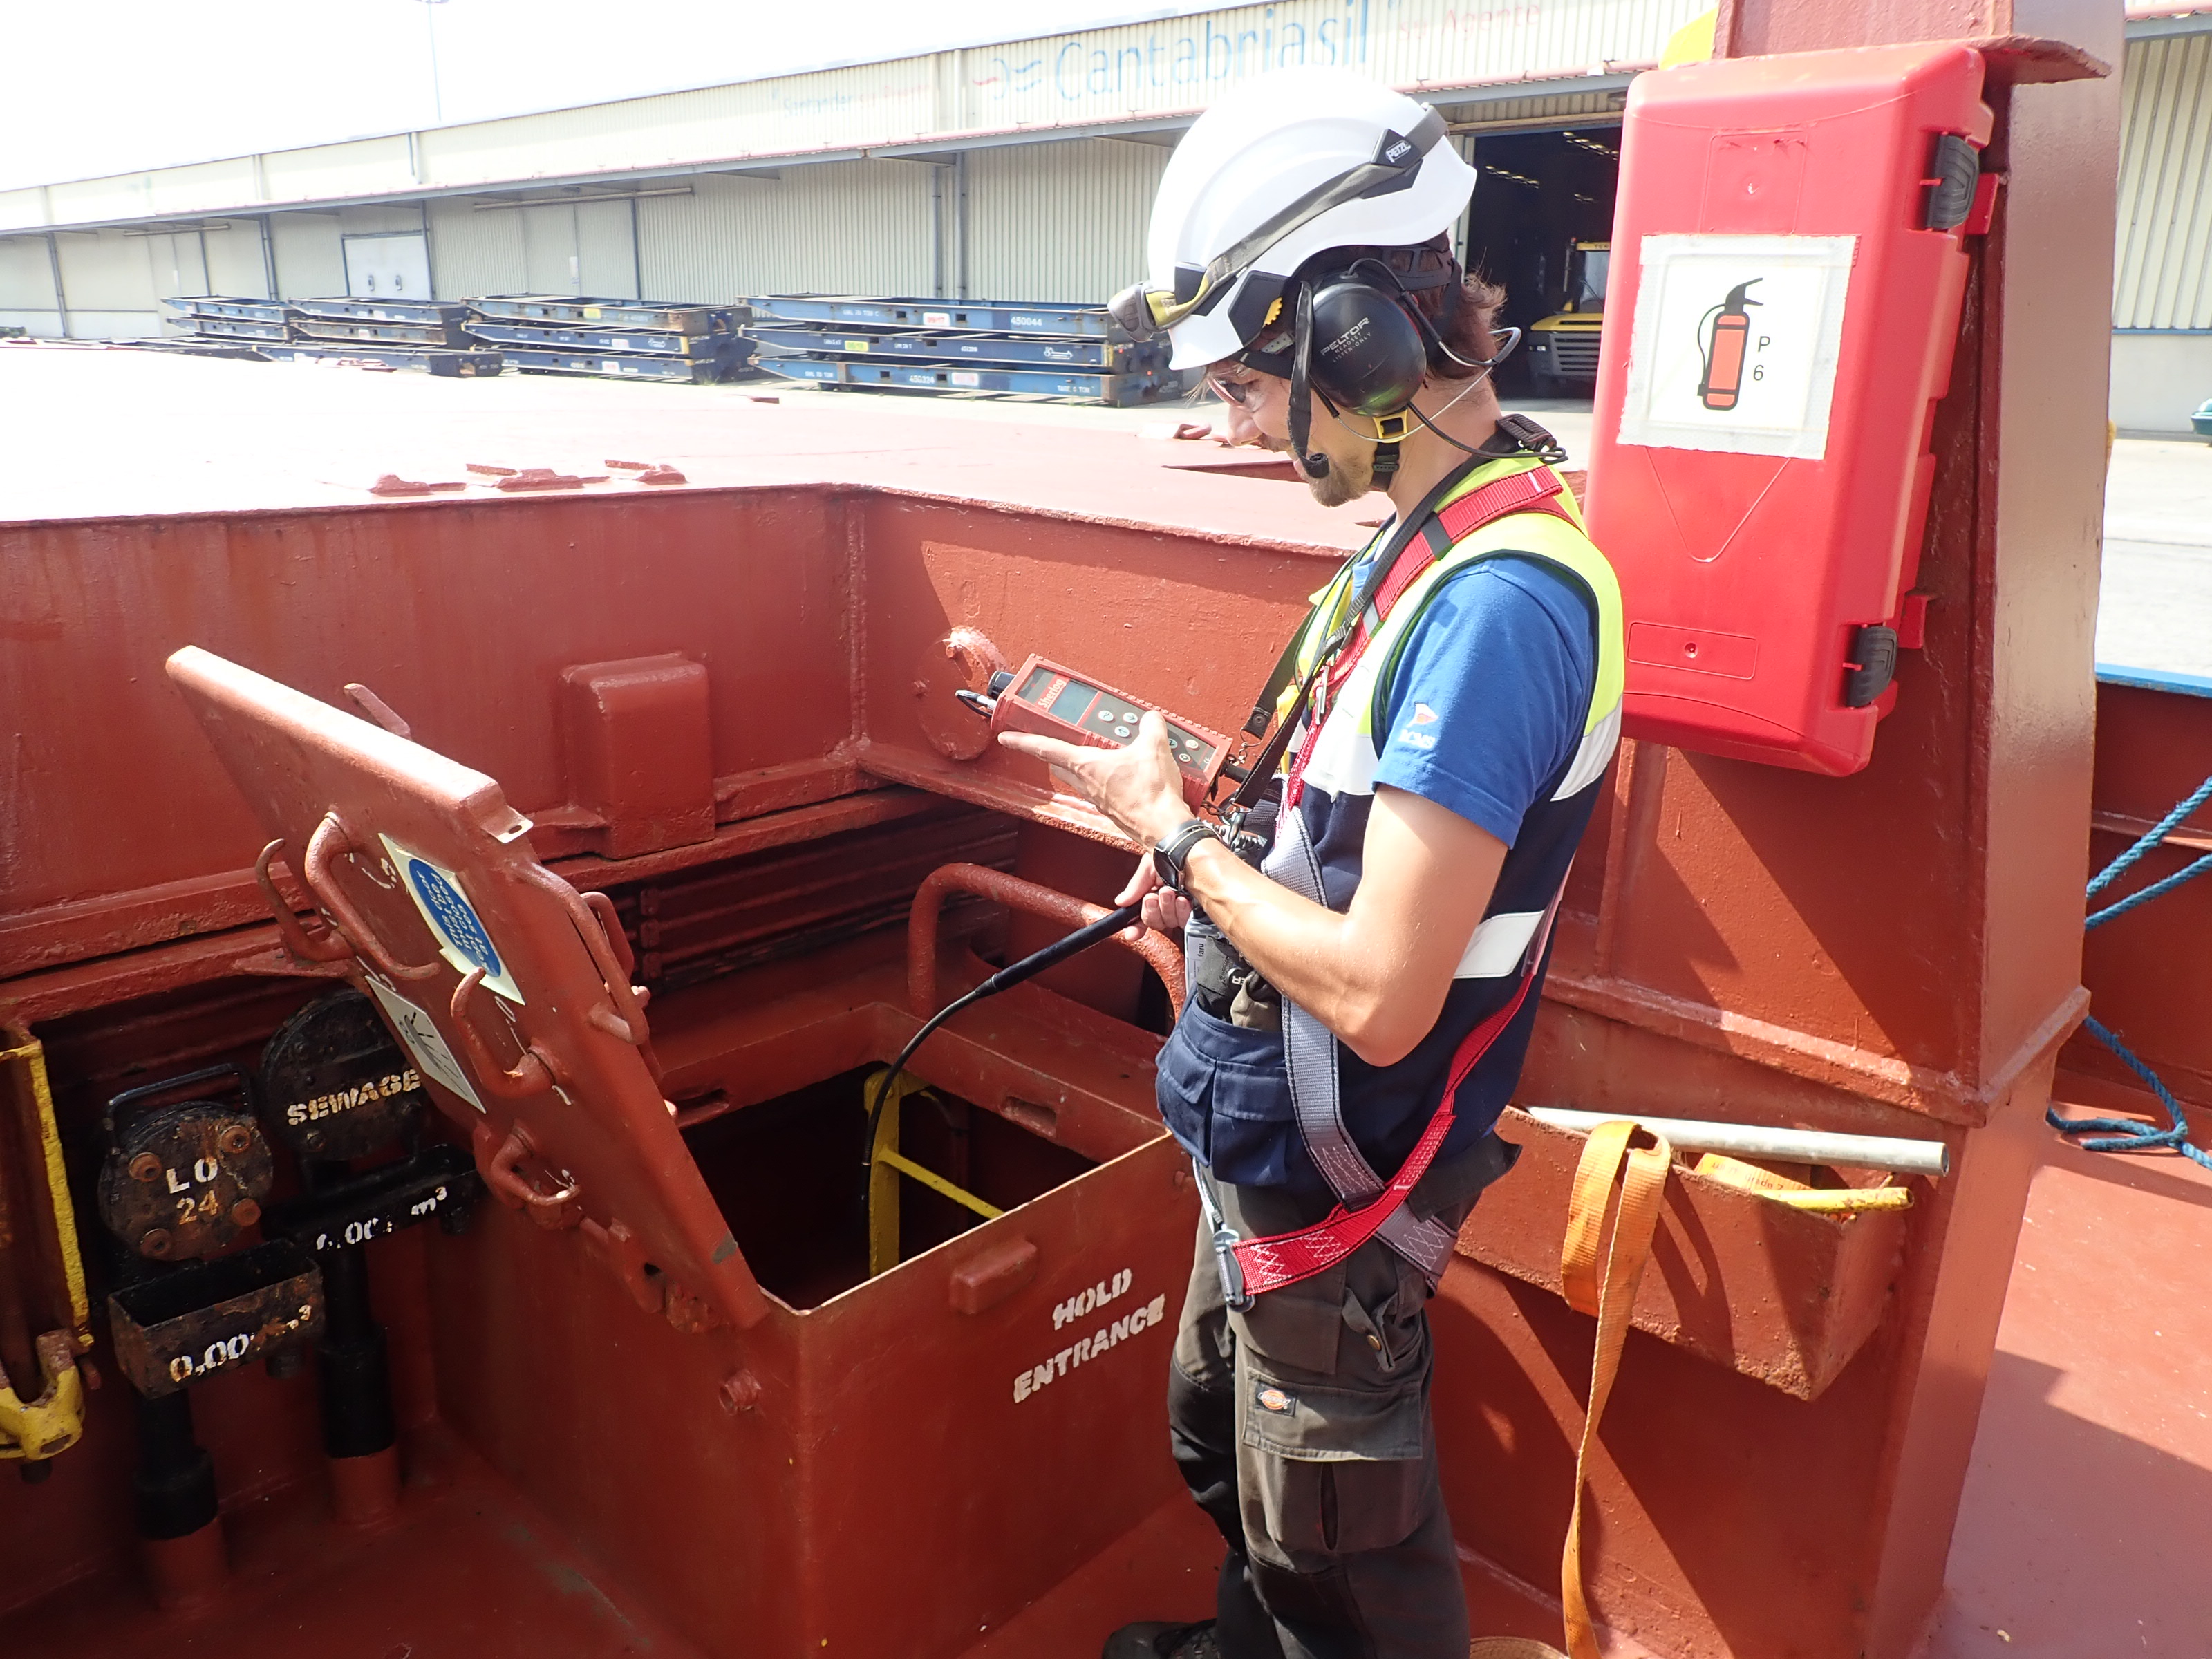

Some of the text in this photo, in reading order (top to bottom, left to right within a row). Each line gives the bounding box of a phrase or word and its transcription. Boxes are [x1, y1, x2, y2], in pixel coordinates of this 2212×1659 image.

[1442, 4, 1541, 41] Agente
[1055, 0, 1369, 101] Cantabriasil
[1386, 142, 1412, 163] PETZL
[1011, 316, 1042, 326] 450044
[1320, 317, 1370, 356] PELTOR
[1335, 332, 1362, 353] HEADSET
[1757, 336, 1771, 353] P
[1753, 364, 1764, 381] 6
[1038, 679, 1067, 708] Sherlog
[416, 871, 462, 946] This door
[431, 872, 467, 930] closed
[431, 883, 472, 950] must be
[457, 903, 489, 955] at sea
[287, 1069, 421, 1125] SEWAGE
[178, 1190, 218, 1225] 24
[1052, 1268, 1132, 1331] HOLD
[1013, 1293, 1166, 1404] ENTRANCE
